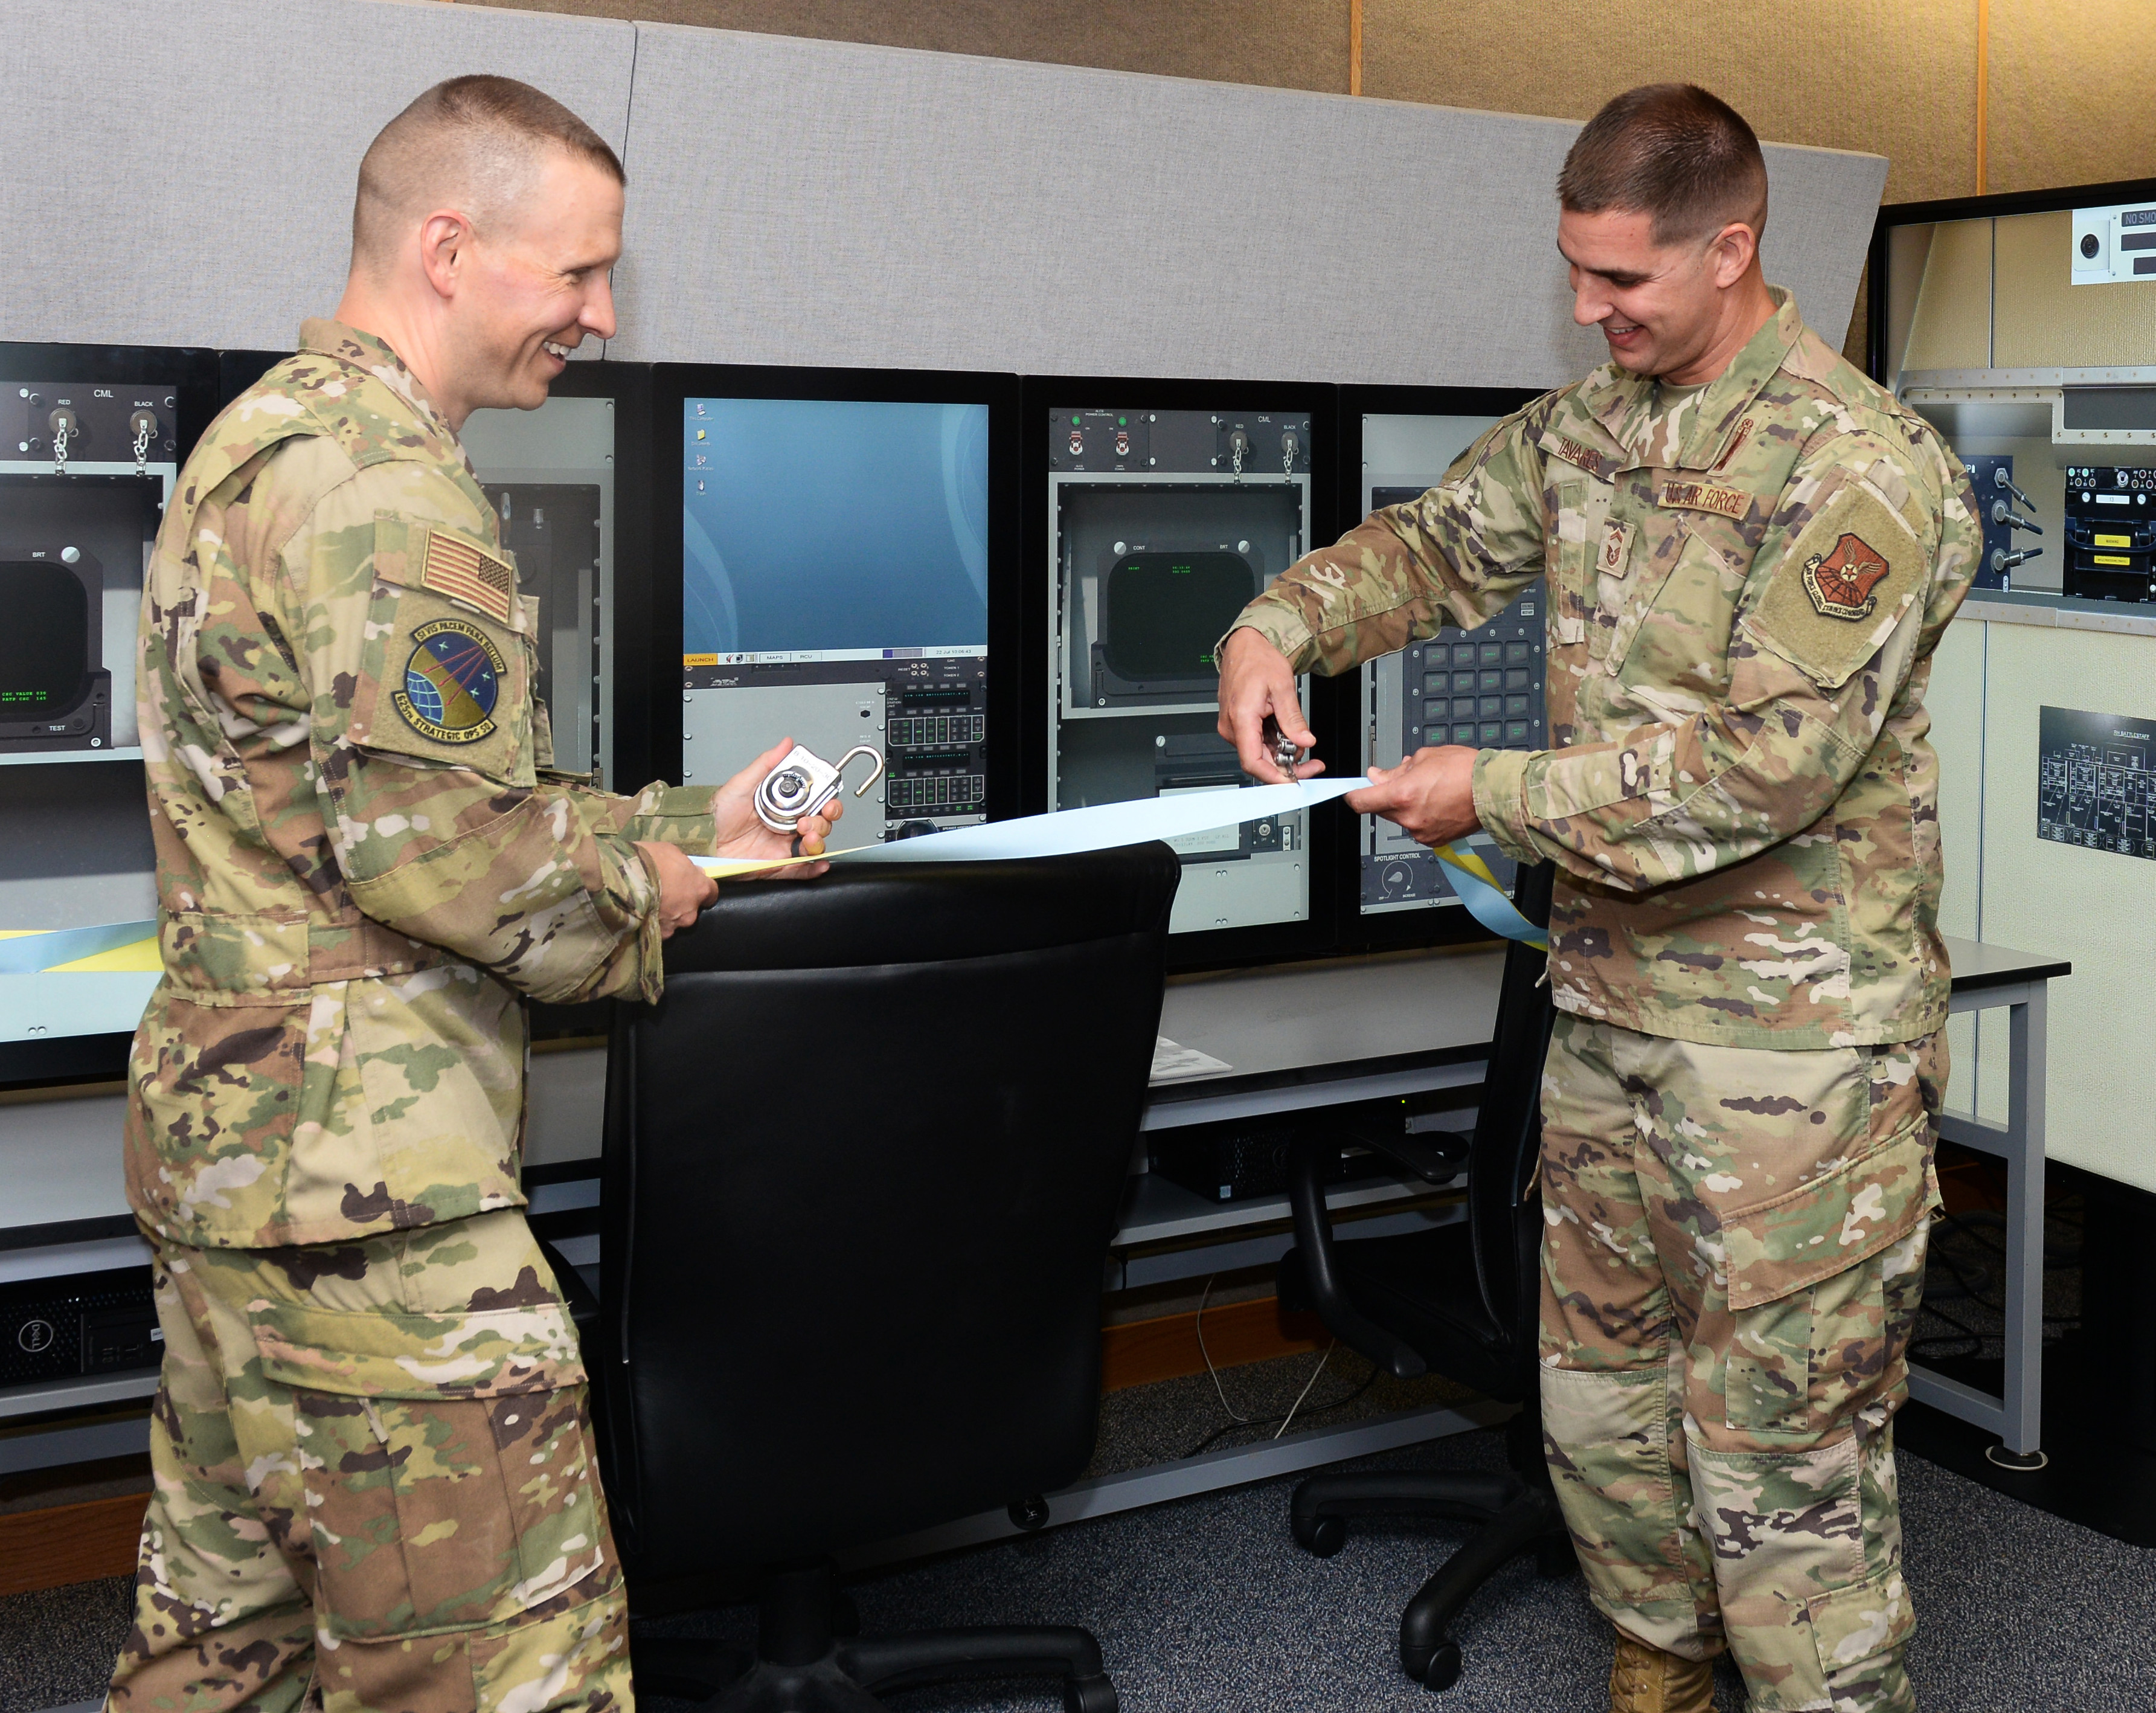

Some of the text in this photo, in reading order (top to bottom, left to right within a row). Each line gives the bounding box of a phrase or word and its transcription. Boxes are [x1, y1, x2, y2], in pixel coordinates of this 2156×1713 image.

[2125, 213, 2137, 225] NO
[94, 390, 114, 398] CML
[1558, 436, 1603, 472] TAVARES
[1683, 486, 1704, 506] AIR
[1702, 489, 1745, 514] FORCE
[417, 622, 502, 672] SI VIS PACEM PARA BELLUM
[397, 695, 491, 741] 625TH STRATEGIC OPS SQ
[2120, 730, 2150, 739] BATTLESTAFF
[1374, 854, 1399, 863] SPOTLIGHT
[31, 1323, 41, 1349] DELL
